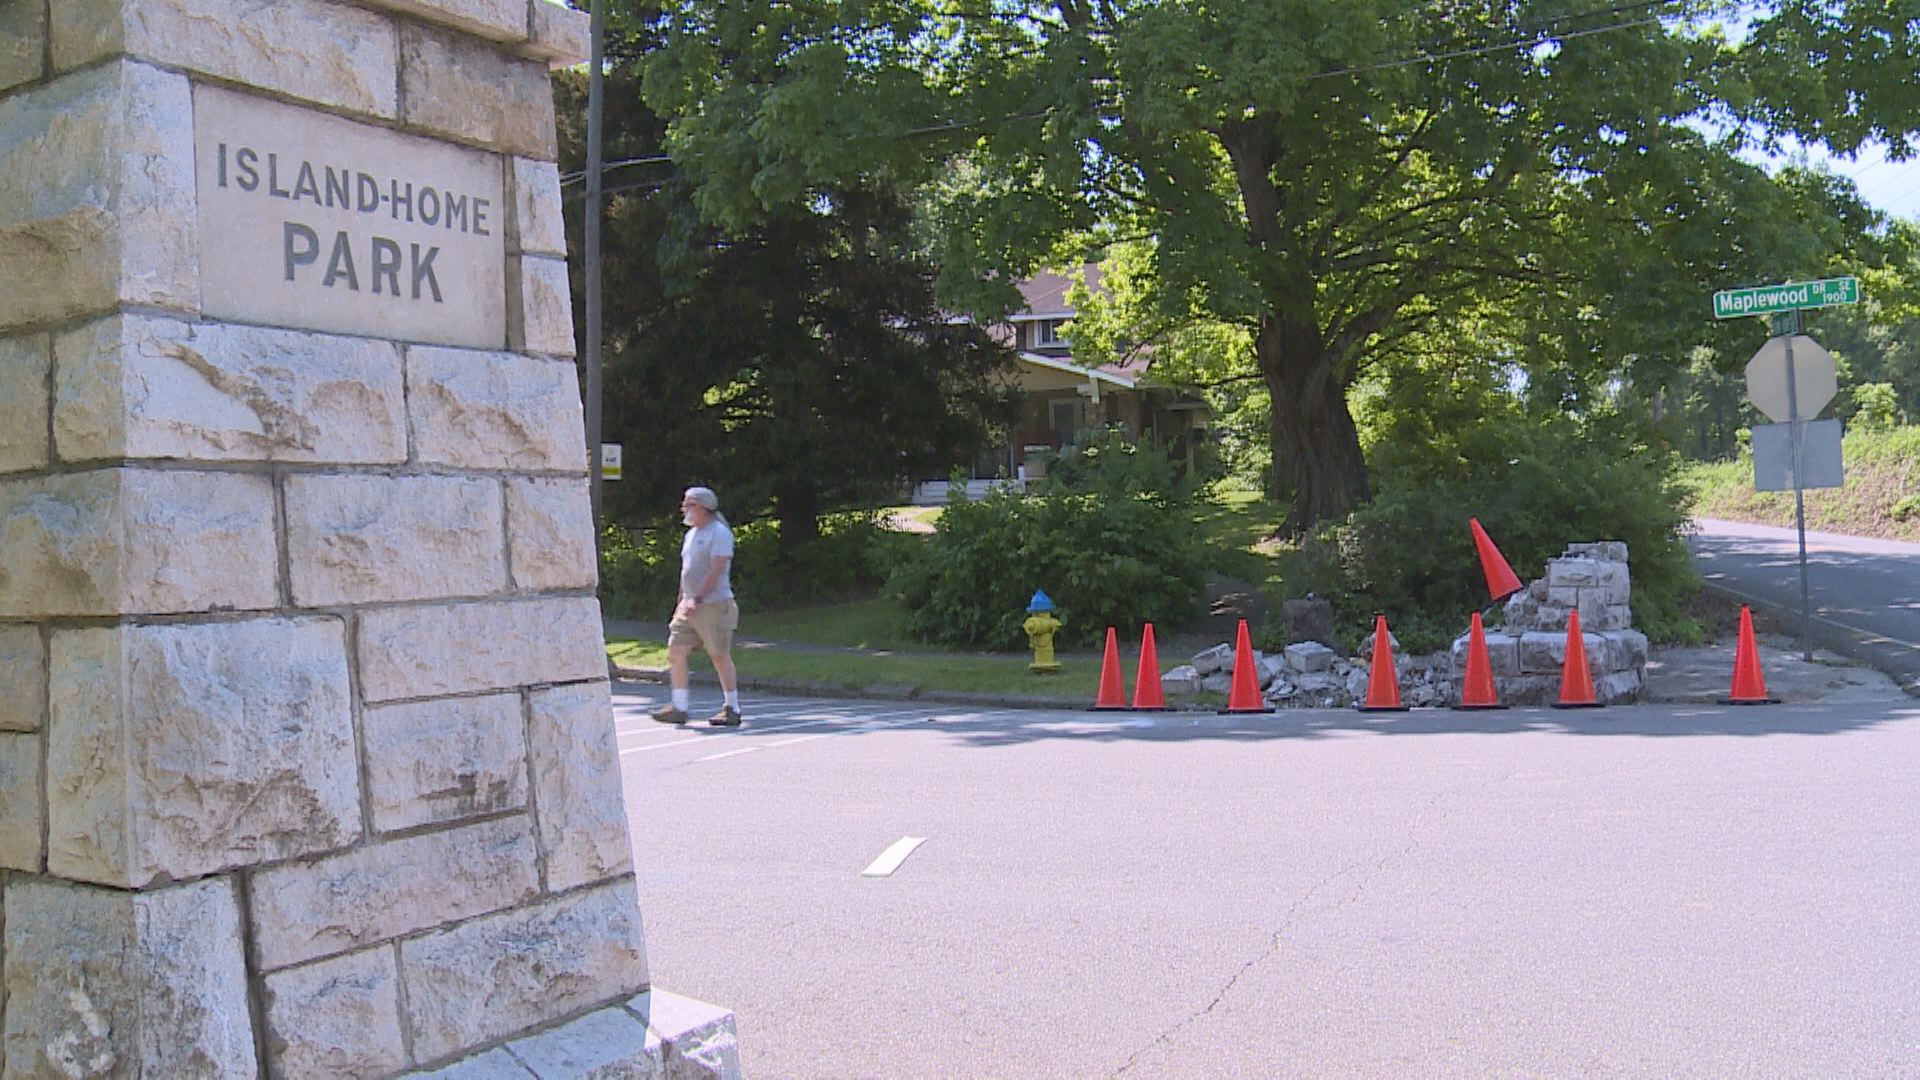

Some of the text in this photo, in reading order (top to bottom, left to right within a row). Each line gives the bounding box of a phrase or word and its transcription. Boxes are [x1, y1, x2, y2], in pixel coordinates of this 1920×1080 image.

[217, 143, 490, 236] ISLAND-HOME
[283, 221, 443, 303] PARK
[1719, 286, 1808, 312] Maplewood
[1812, 283, 1826, 295] DR
[1823, 291, 1847, 303] 1900
